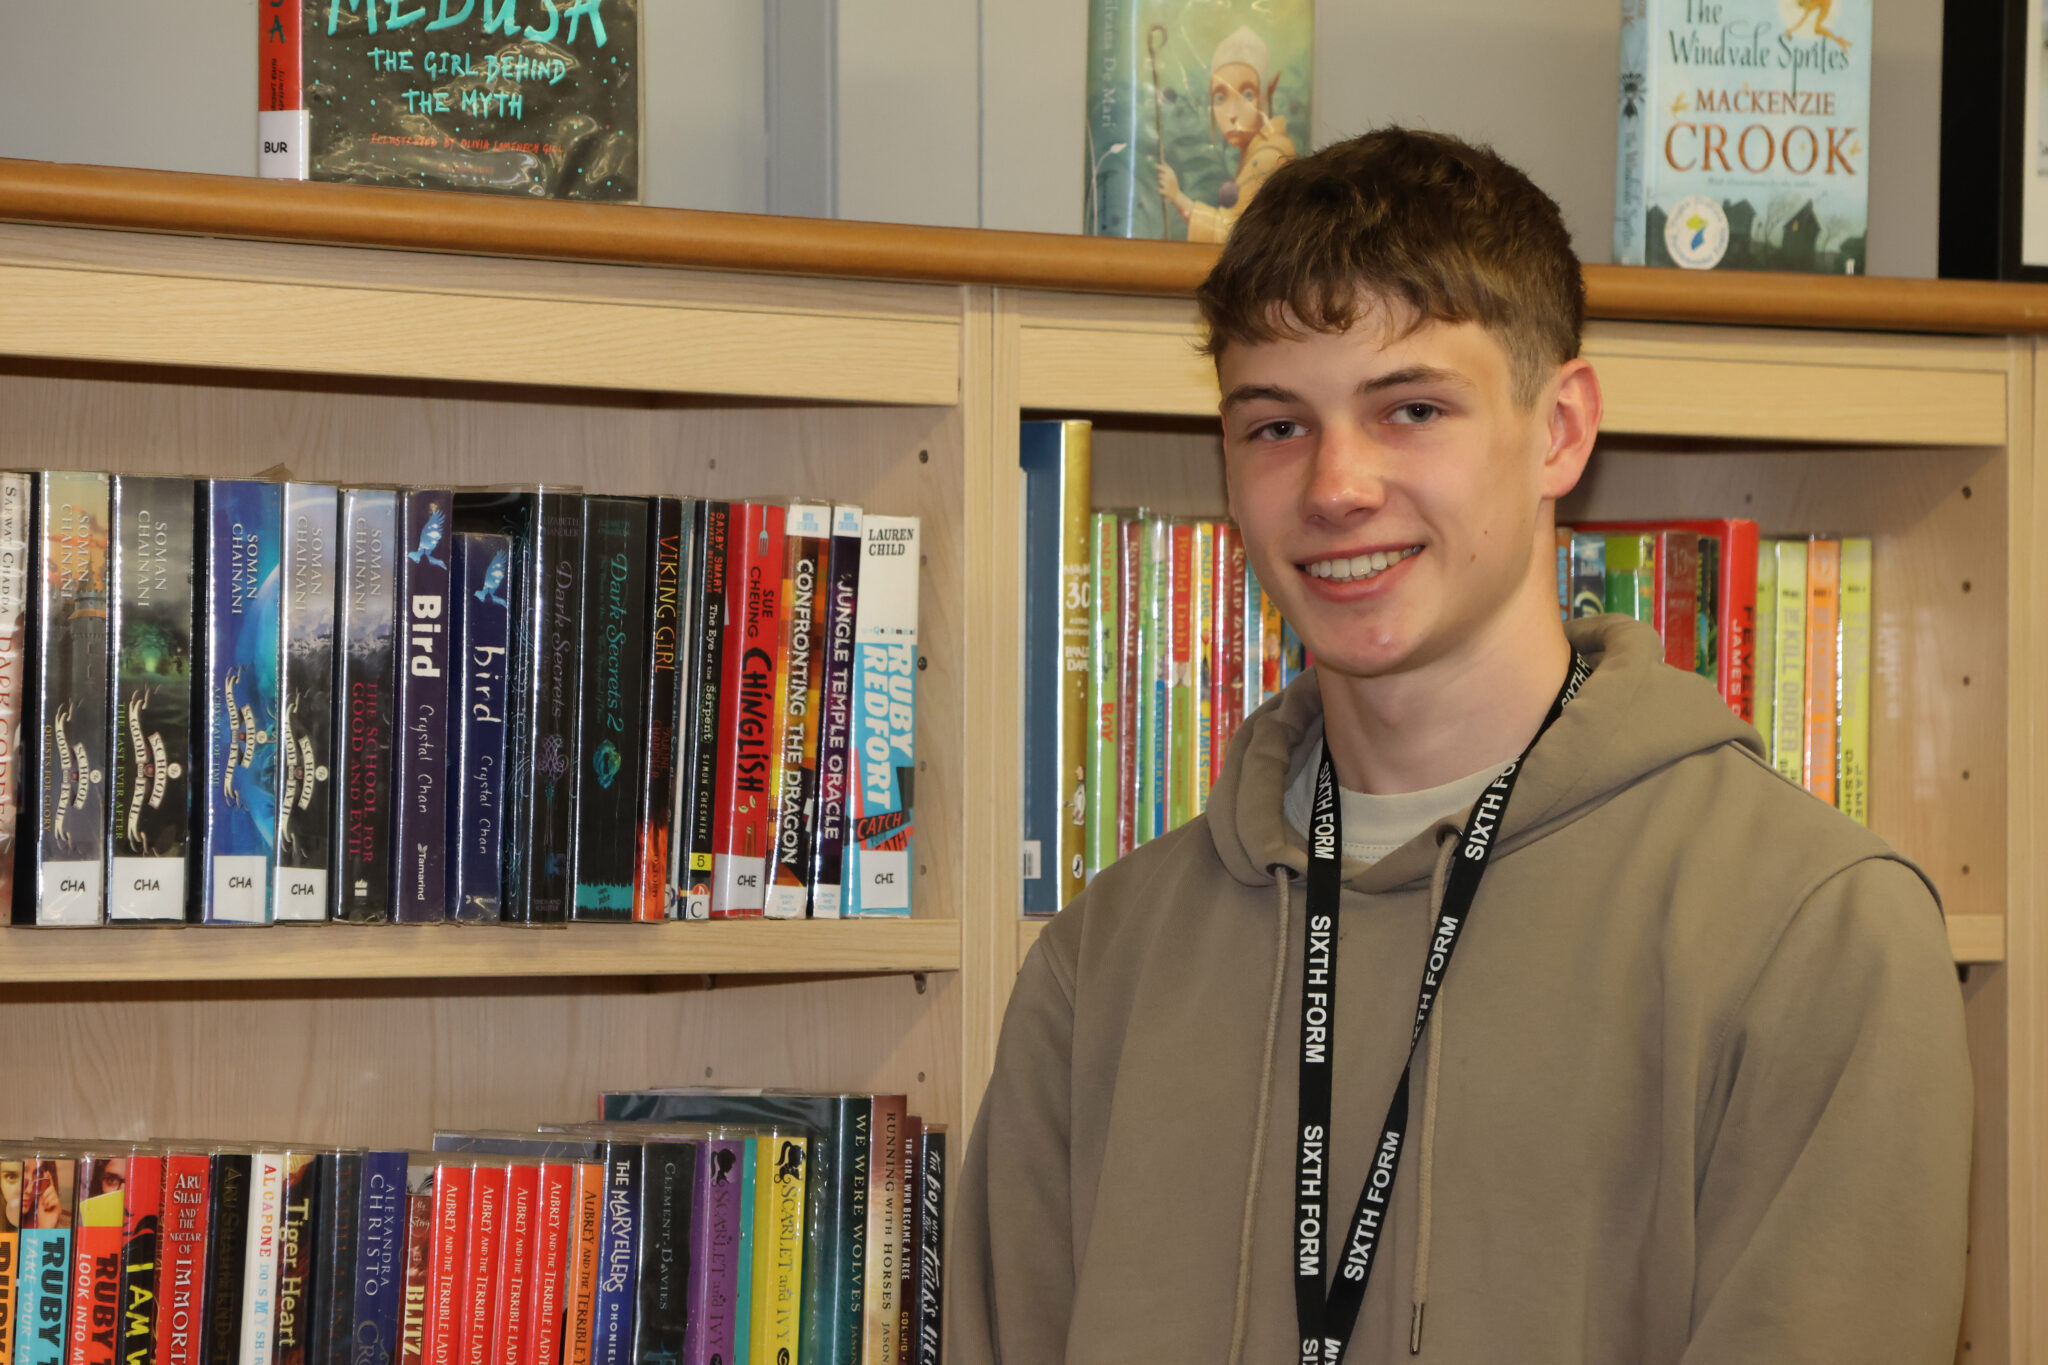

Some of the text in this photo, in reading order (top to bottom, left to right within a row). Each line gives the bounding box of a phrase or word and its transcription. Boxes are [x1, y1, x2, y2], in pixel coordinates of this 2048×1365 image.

[367, 47, 567, 85] THE GIRL BEHIND
[1669, 22, 1770, 67] Windvale
[401, 88, 523, 119] THE MYTH
[1696, 88, 1836, 116] MACKENZIE
[264, 141, 288, 154] BUR
[1664, 121, 1858, 175] CROOK
[61, 503, 73, 598] CHAINANI
[78, 515, 89, 582] SOMAN
[138, 510, 150, 606] CHAINANI
[154, 522, 168, 591] SOMAN
[232, 523, 244, 615] CHAINANI
[247, 534, 258, 600] SOMAN
[295, 515, 308, 611] CHAINANI
[311, 528, 323, 595] SOMAN
[712, 512, 726, 595] SAXBY SMART
[868, 528, 914, 542] LAUREN
[868, 544, 906, 556] CHILD
[608, 553, 629, 620] Dark
[656, 535, 679, 619] VIKING
[747, 566, 761, 638] CHEUNG
[762, 589, 774, 618] SUE
[411, 595, 442, 678] Bird
[551, 561, 573, 717] Dark Secrets
[654, 627, 675, 673] GIRL
[706, 628, 718, 660] Eye
[709, 605, 719, 627] The
[788, 558, 814, 717] CONFRONTING
[1783, 629, 1799, 675] KILL
[472, 646, 506, 723] bird
[605, 624, 627, 710] Secrets
[707, 653, 714, 663] of
[1731, 619, 1742, 696] JAMES
[1743, 606, 1755, 718] FEVER
[352, 682, 365, 752] GOOD
[607, 712, 625, 732] 2
[702, 685, 716, 740] Serpent
[824, 579, 853, 840] JUNGLE TEMPLE ORACLE
[888, 643, 913, 758] RUBY
[1101, 702, 1114, 743] BOY
[1781, 680, 1799, 753] ORDER
[114, 704, 125, 840] THE LAST EVER AFTER
[364, 728, 378, 818] SCHOOL
[409, 704, 435, 813] Crystal Chan
[786, 723, 806, 764] THE
[1200, 713, 1211, 768] JAMES
[350, 761, 363, 801] AND
[473, 755, 494, 854] Crystal Chan
[698, 753, 710, 841] SIMON CHESHIRE
[1314, 761, 1335, 860] SIXTH FORM
[362, 824, 376, 863] FOR
[780, 771, 802, 864] DRAGON
[857, 812, 902, 839] CATCH
[1465, 792, 1504, 861] SIXTH
[60, 880, 86, 892] CHA
[134, 879, 160, 891] CHA
[228, 877, 253, 889] CHA
[417, 852, 428, 901] Tamarind
[697, 854, 705, 868] 5
[737, 874, 757, 887] CHE
[875, 872, 894, 885] CHI
[1425, 916, 1459, 986] FORM
[1305, 915, 1332, 1063] SIXTH FORM
[173, 1190, 202, 1205] SHAH
[175, 1173, 202, 1189] ARU
[178, 1208, 196, 1218] AND
[259, 1164, 277, 1257] AL CAPONE
[850, 1114, 867, 1313] WE WERE WOLVES
[901, 1138, 912, 1281] THE GIRL WHO BECAME A TREE
[1299, 1125, 1324, 1276] SIXTH FORM
[1343, 1131, 1400, 1282] SIXTH FORM
[169, 1232, 202, 1242] NECTAR
[178, 1219, 194, 1229] THE
[178, 1244, 191, 1254] OF
[364, 1174, 384, 1297] CHRISTO
[381, 1183, 395, 1287] ALEXANDRA
[437, 1184, 458, 1331] AUBREY AND THE TERRIBLE
[602, 1160, 632, 1293] THE MARVELLERS
[881, 1113, 896, 1363] RUNNING WITH HORSES JASON
[21, 1237, 39, 1337] TAKE YOUR
[38, 1237, 66, 1348] RUBY
[75, 1252, 91, 1342] LOOK INTO
[278, 1197, 310, 1348] Tiger Heart
[574, 1190, 597, 1356] AUBREY AND THE TERRIBLE
[709, 1186, 730, 1350] SCARLET IVY
[776, 1183, 798, 1341] SCARLET IVY
[91, 1253, 118, 1348] RUBY
[125, 1263, 154, 1338] I AM
[403, 1285, 425, 1357] BLITZ
